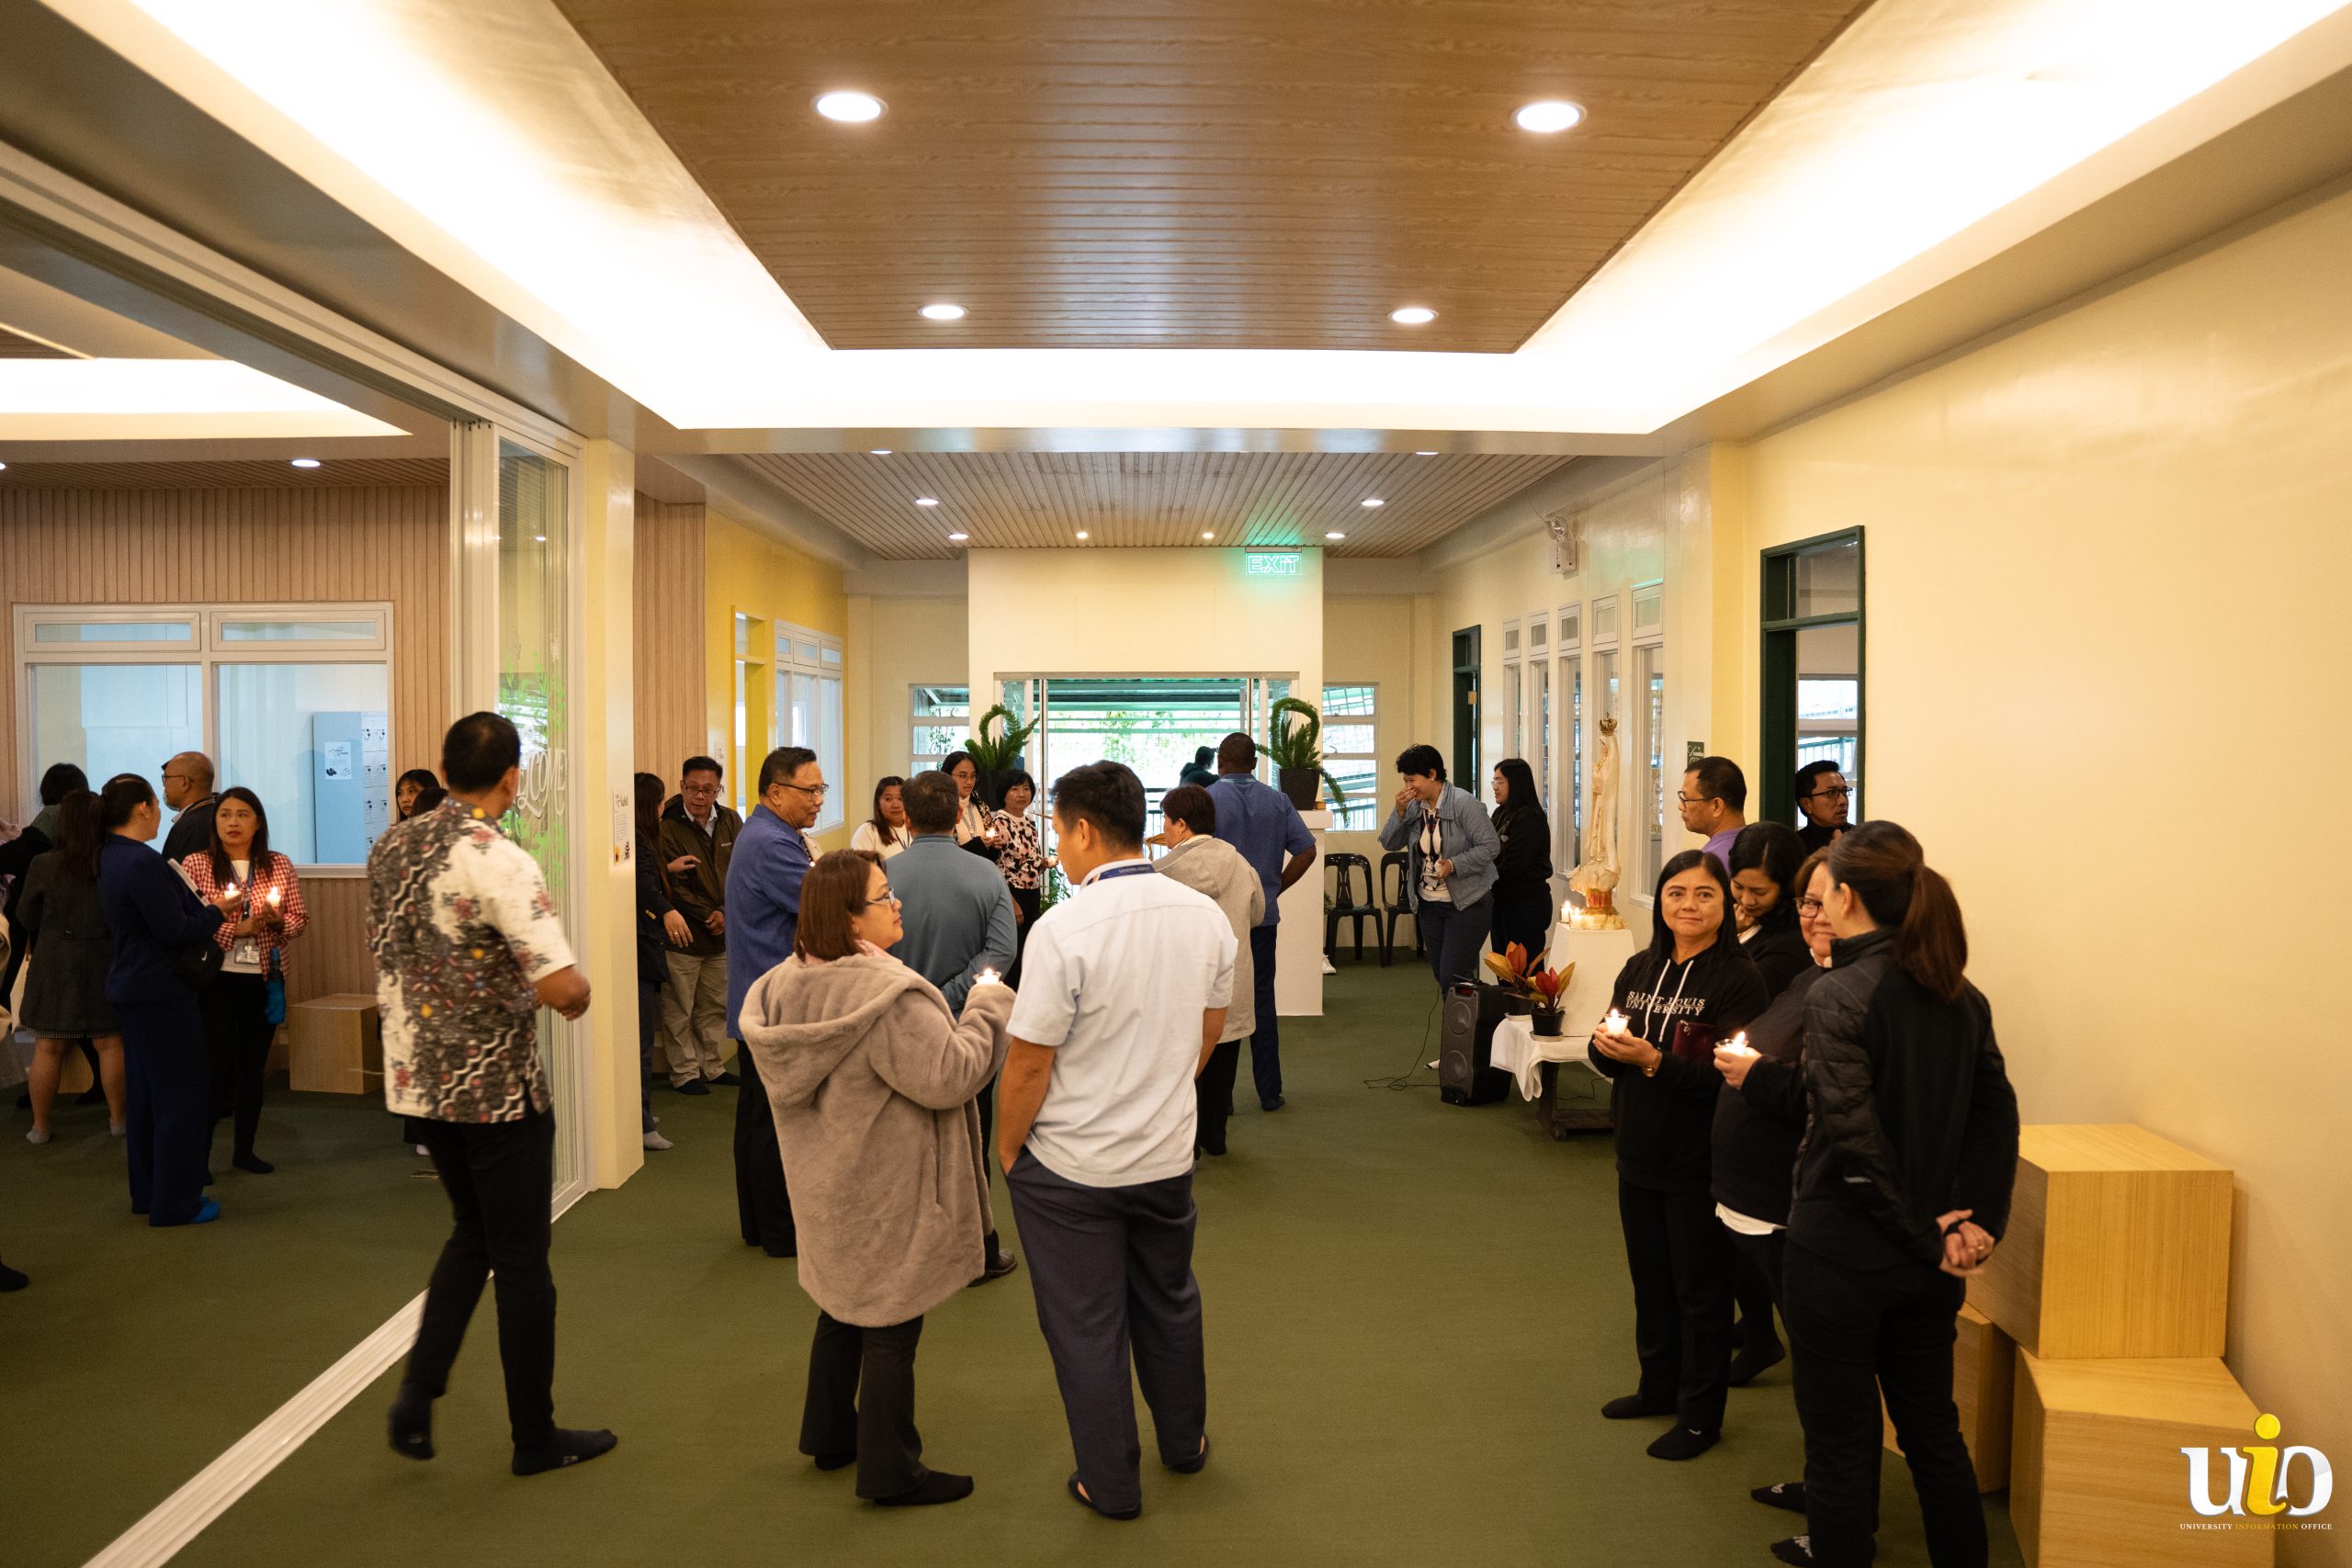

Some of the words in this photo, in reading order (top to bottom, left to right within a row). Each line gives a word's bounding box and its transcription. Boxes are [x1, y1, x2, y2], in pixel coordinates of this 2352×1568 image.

[1247, 555, 1299, 574] EXIT
[513, 747, 567, 818] ELCOME
[1627, 990, 1665, 1004] SAINT
[1667, 996, 1706, 1008] LOUIS
